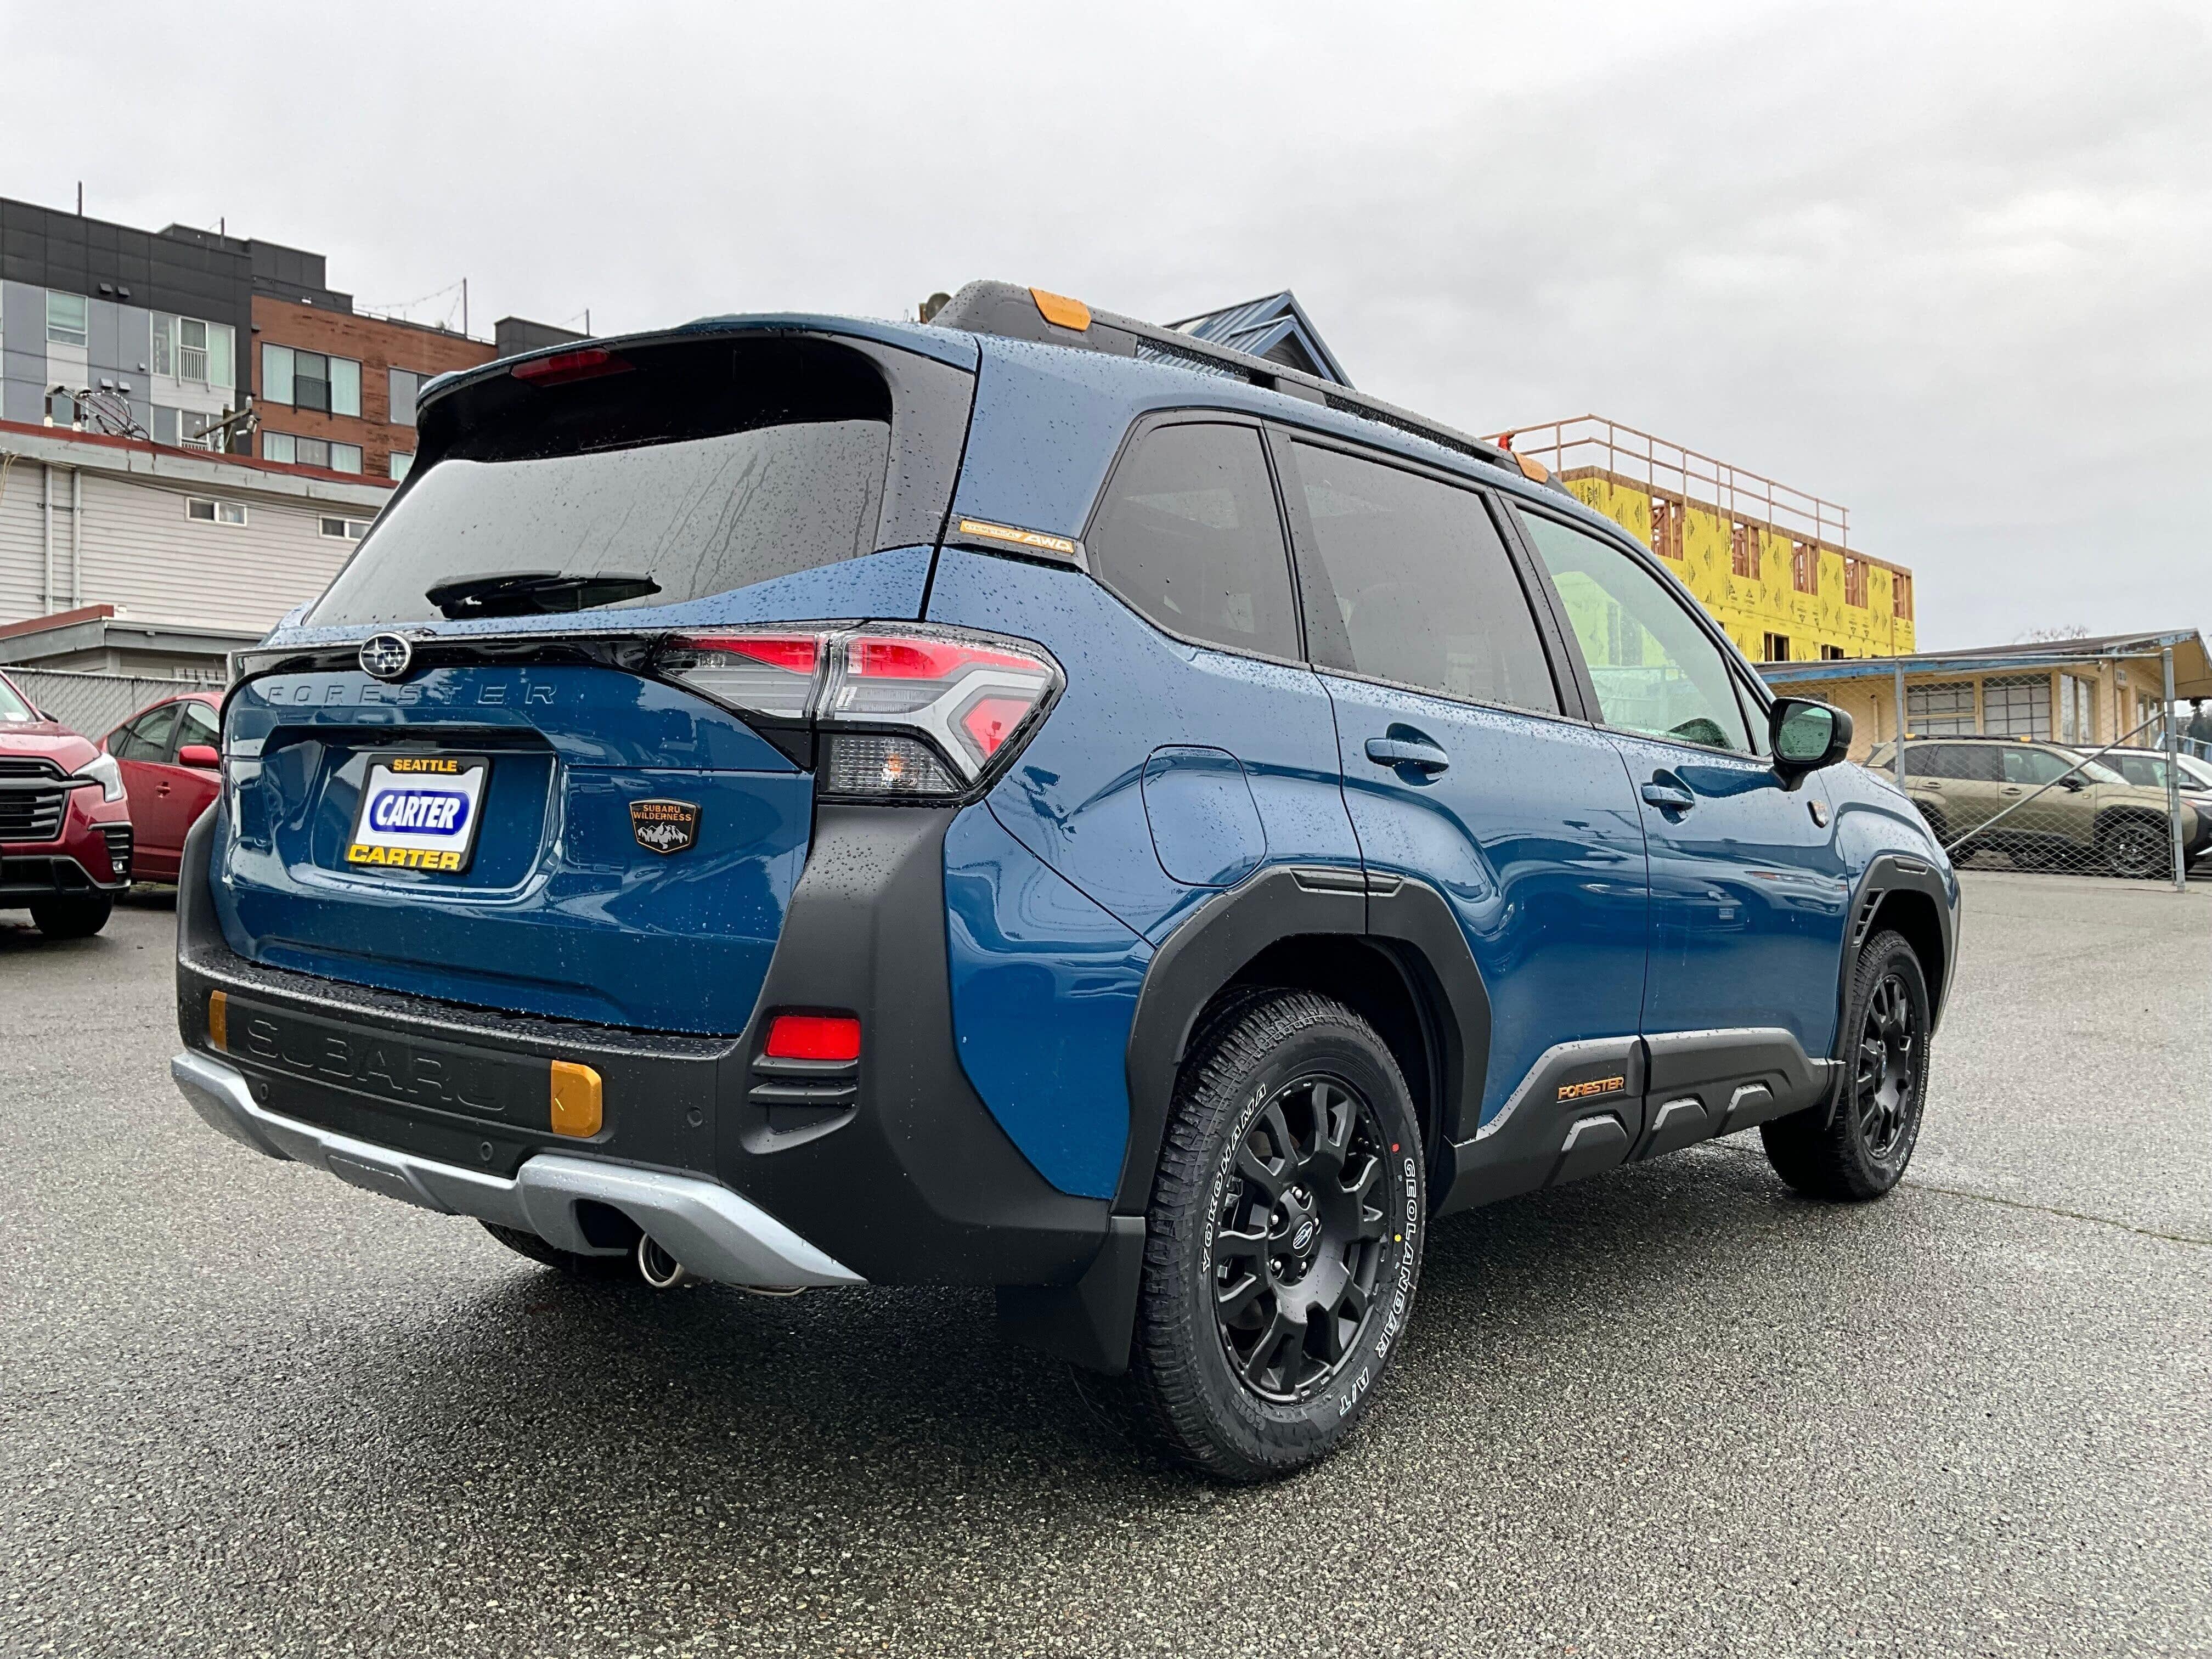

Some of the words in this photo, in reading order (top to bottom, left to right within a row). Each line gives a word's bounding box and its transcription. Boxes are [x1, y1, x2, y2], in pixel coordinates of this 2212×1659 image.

[1024, 535, 1073, 550] AWD
[267, 684, 557, 704] FORESTER
[393, 759, 458, 772] SEATTLE
[376, 795, 460, 829] CARTER
[633, 811, 691, 821] WILDERNESS
[643, 805, 680, 813] SUBARU
[348, 845, 460, 870] CARTER
[247, 1019, 506, 1111] SUBARU
[1558, 1077, 1624, 1100] FORESTER
[1203, 1084, 1266, 1272] YOKOHAMA
[1375, 1158, 1417, 1358] GEOLANDAR
[1339, 1367, 1369, 1416] A/T
